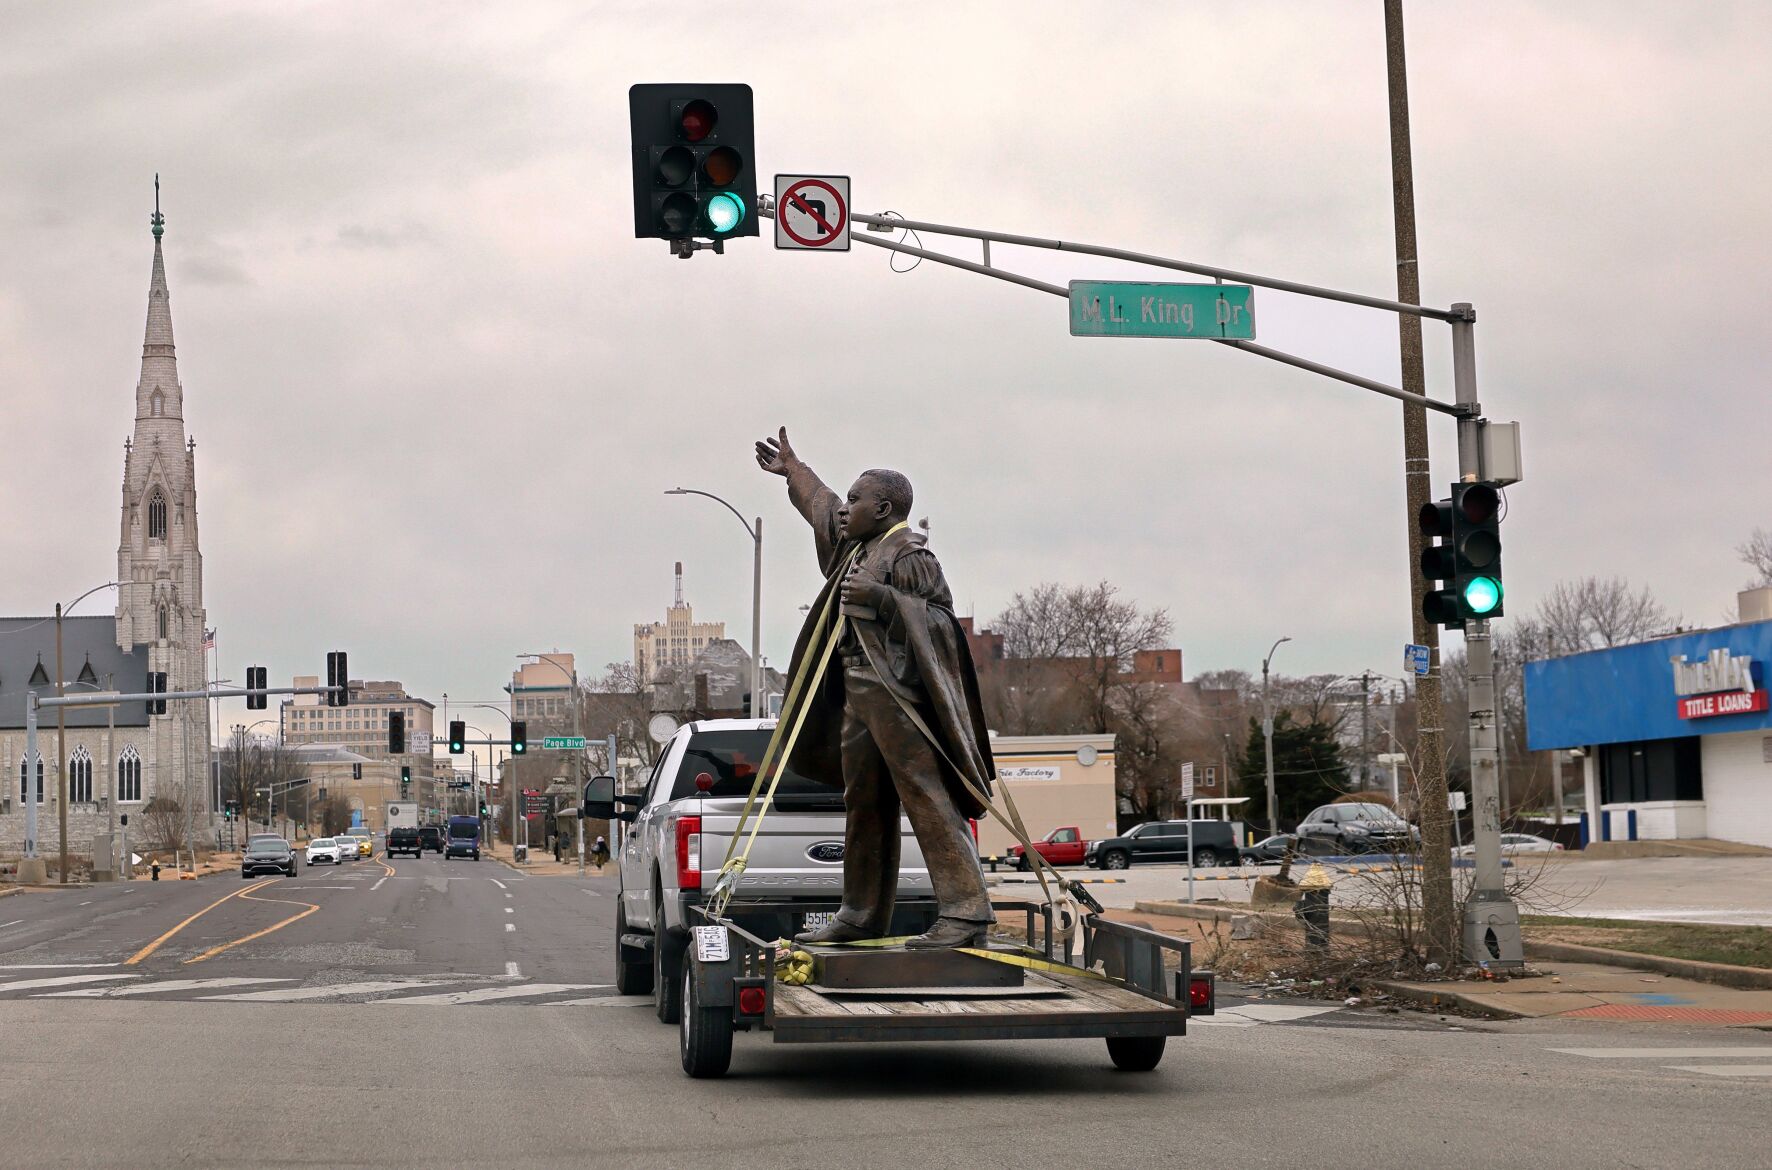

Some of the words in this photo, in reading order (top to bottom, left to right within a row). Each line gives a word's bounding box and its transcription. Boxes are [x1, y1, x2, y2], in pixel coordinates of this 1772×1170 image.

[1141, 296, 1194, 332] King
[1215, 298, 1243, 325] Dr
[1685, 697, 1715, 717] TITLE
[1717, 693, 1753, 713] LOANS
[545, 739, 565, 749] Page
[566, 739, 584, 747] Blvd
[1016, 768, 1054, 778] Factory
[818, 845, 844, 858] Ford
[740, 876, 840, 885] SUPER
